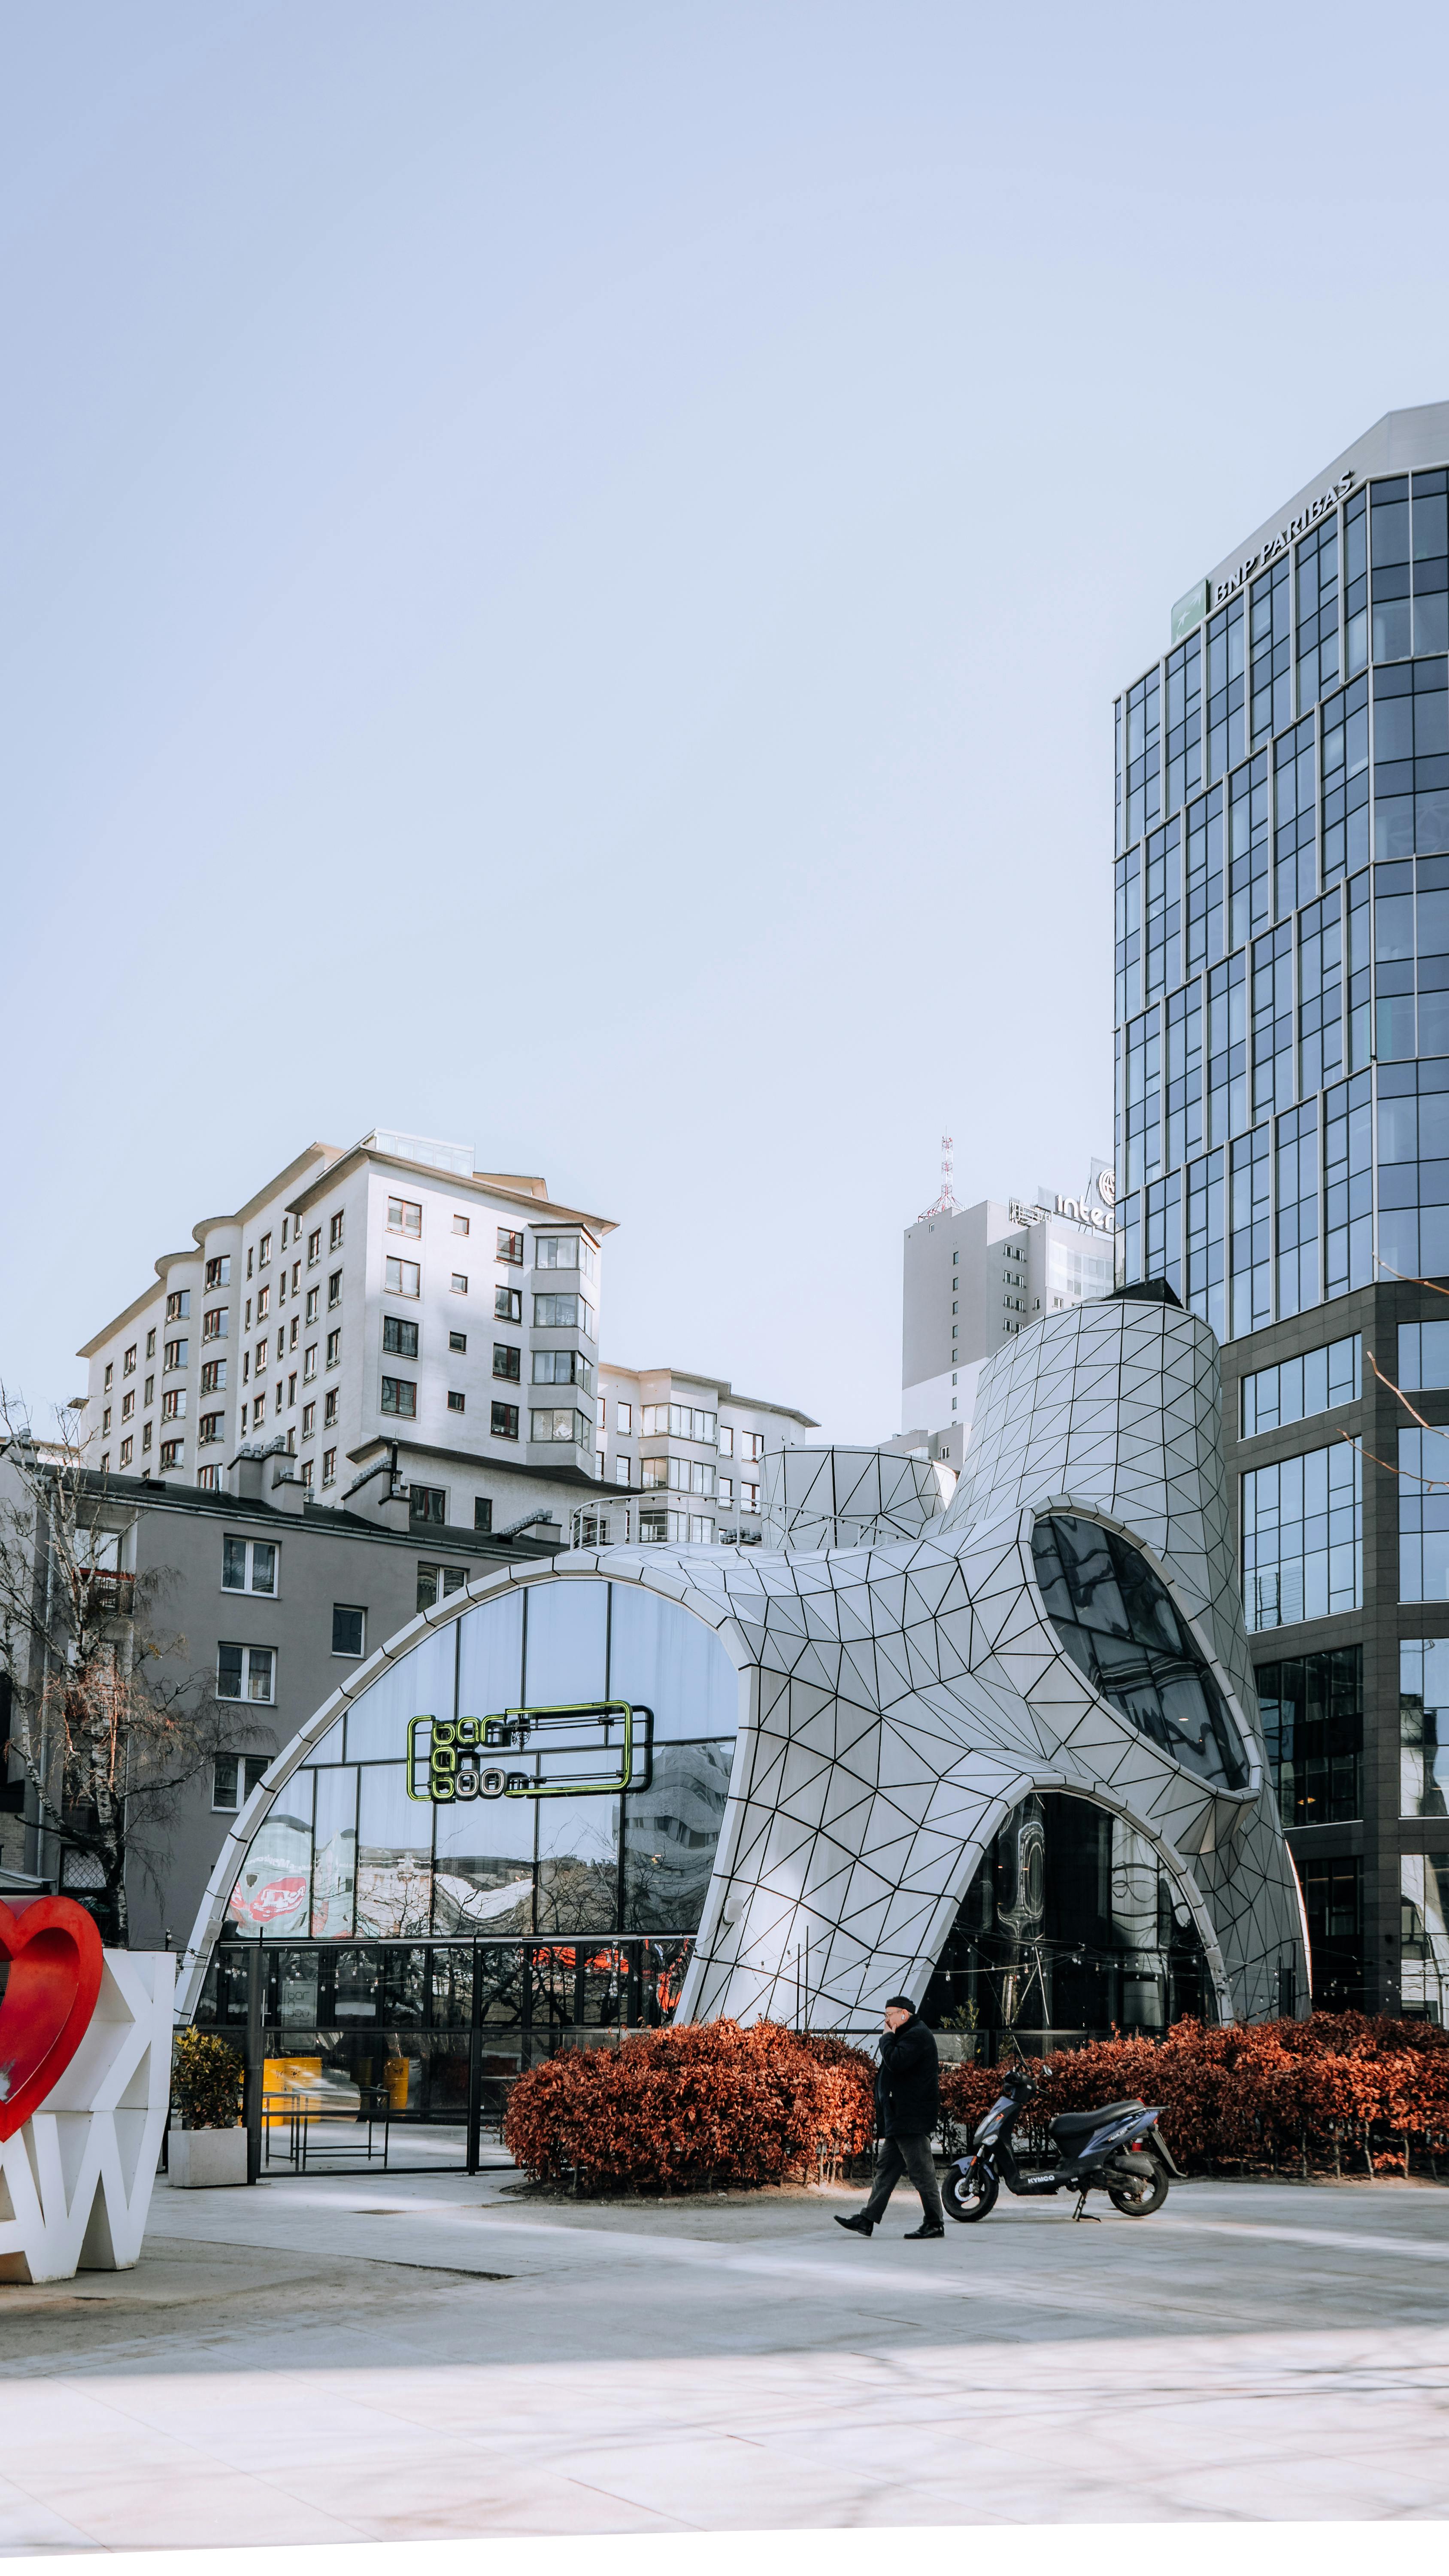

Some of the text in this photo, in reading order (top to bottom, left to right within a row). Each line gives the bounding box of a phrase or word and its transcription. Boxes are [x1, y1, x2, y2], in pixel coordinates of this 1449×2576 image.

[1215, 470, 1353, 606] BNP PARIBAS
[433, 1714, 506, 1745] bar
[288, 1991, 310, 2000] bar
[1028, 2175, 1055, 2184] KYMCO
